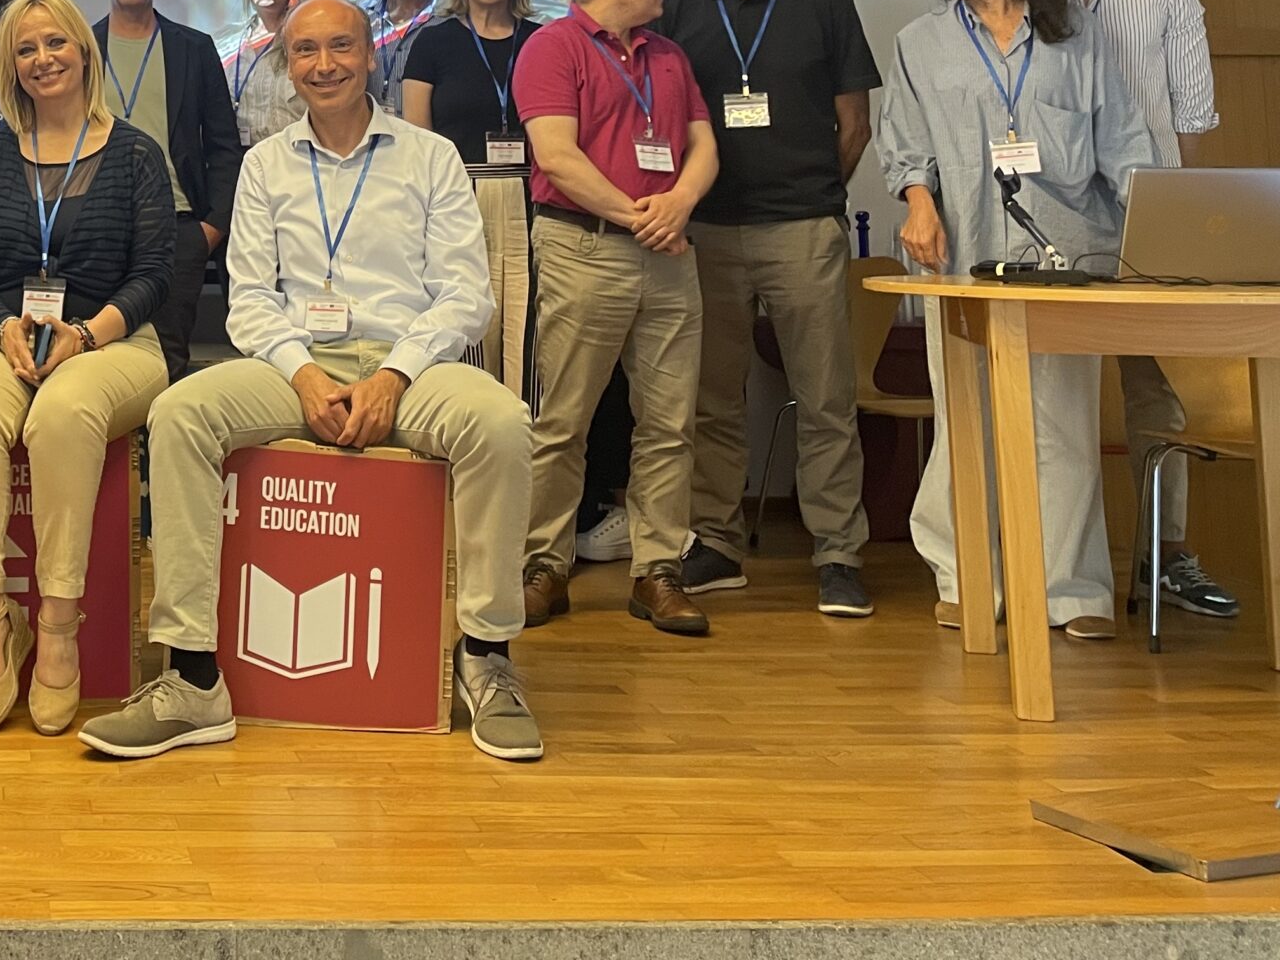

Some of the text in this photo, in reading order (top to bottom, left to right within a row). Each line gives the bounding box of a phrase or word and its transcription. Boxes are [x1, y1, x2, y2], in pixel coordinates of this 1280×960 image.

[221, 472, 240, 525] 4
[261, 475, 337, 505] QUALITY
[259, 505, 360, 538] EDUCATION
